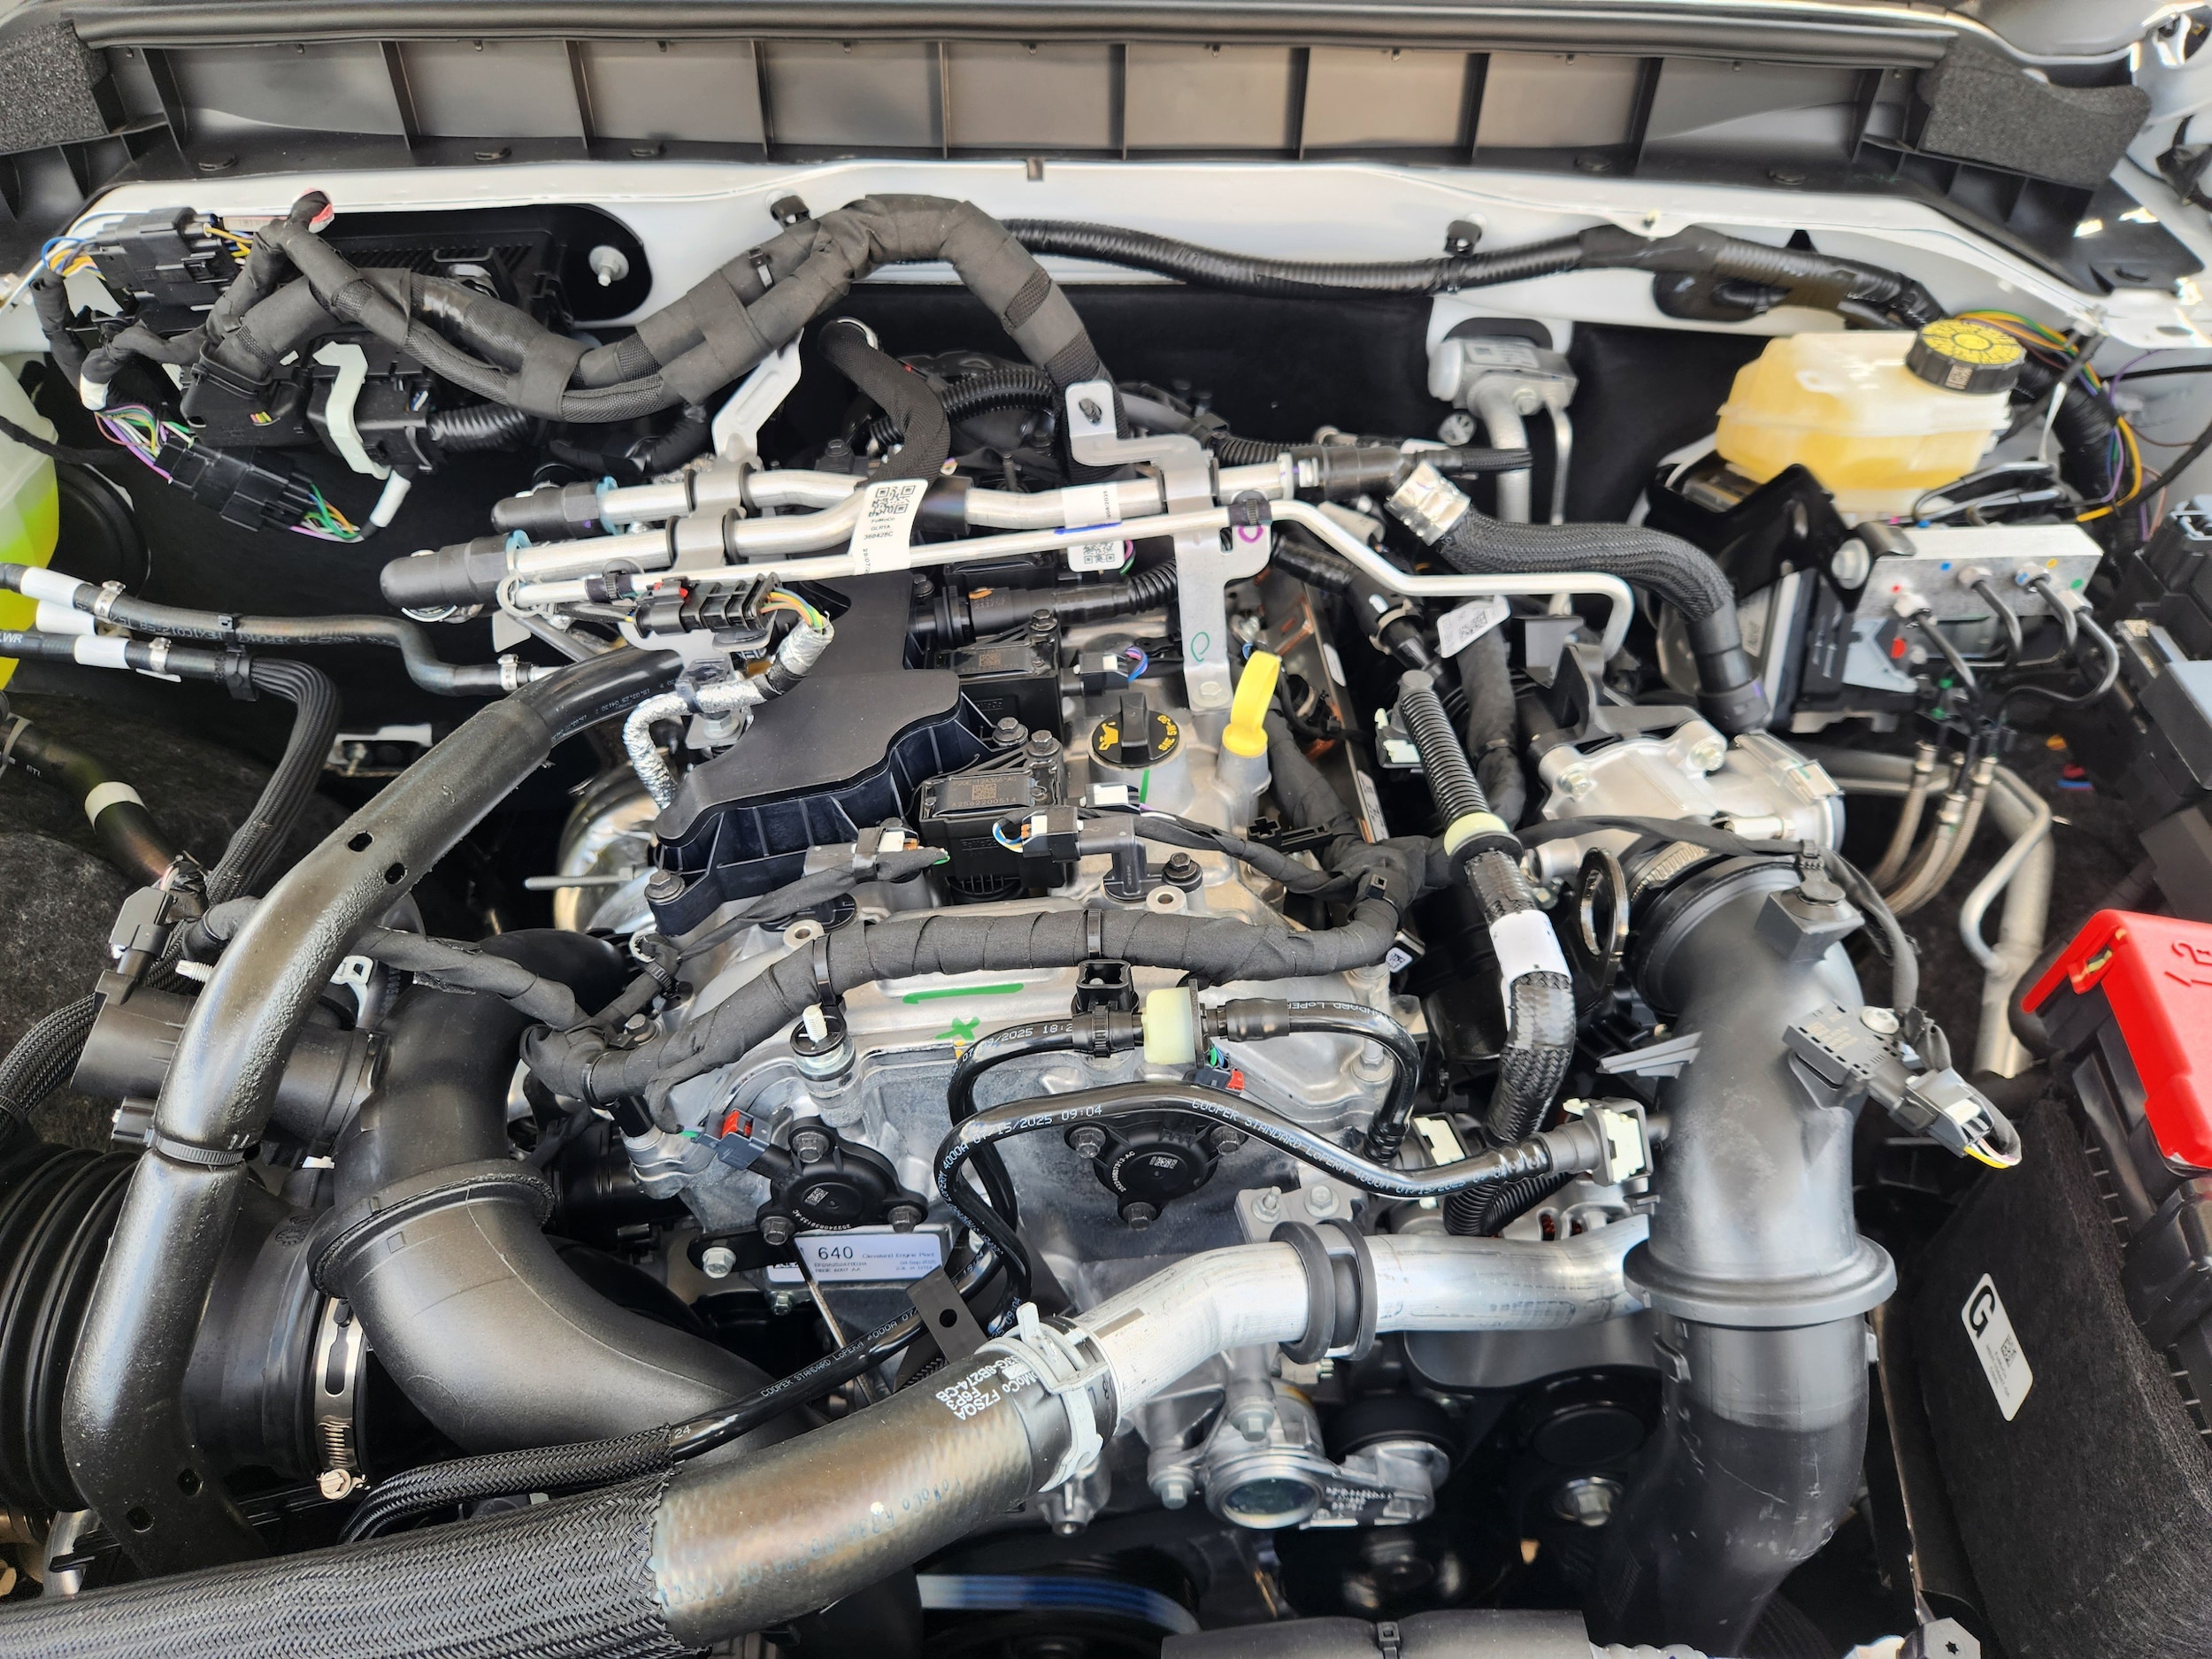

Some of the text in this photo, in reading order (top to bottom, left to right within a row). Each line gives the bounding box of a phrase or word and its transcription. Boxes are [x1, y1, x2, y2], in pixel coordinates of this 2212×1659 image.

[1157, 737, 1175, 750] SAE
[942, 1142, 970, 1170] 4000A
[1061, 1104, 1102, 1121] 09:04
[1192, 1098, 1240, 1122] COOPER
[1244, 1118, 1302, 1149] STANDARD
[1306, 1146, 1350, 1173] LoPERM
[818, 1246, 854, 1260] 640
[1969, 1285, 1995, 1340] G
[760, 1379, 795, 1398] COOPER
[795, 1359, 832, 1382] STANDARD
[946, 1387, 981, 1411] F6P3
[954, 1389, 1002, 1421] FZSQA
[674, 1425, 692, 1440] 24
